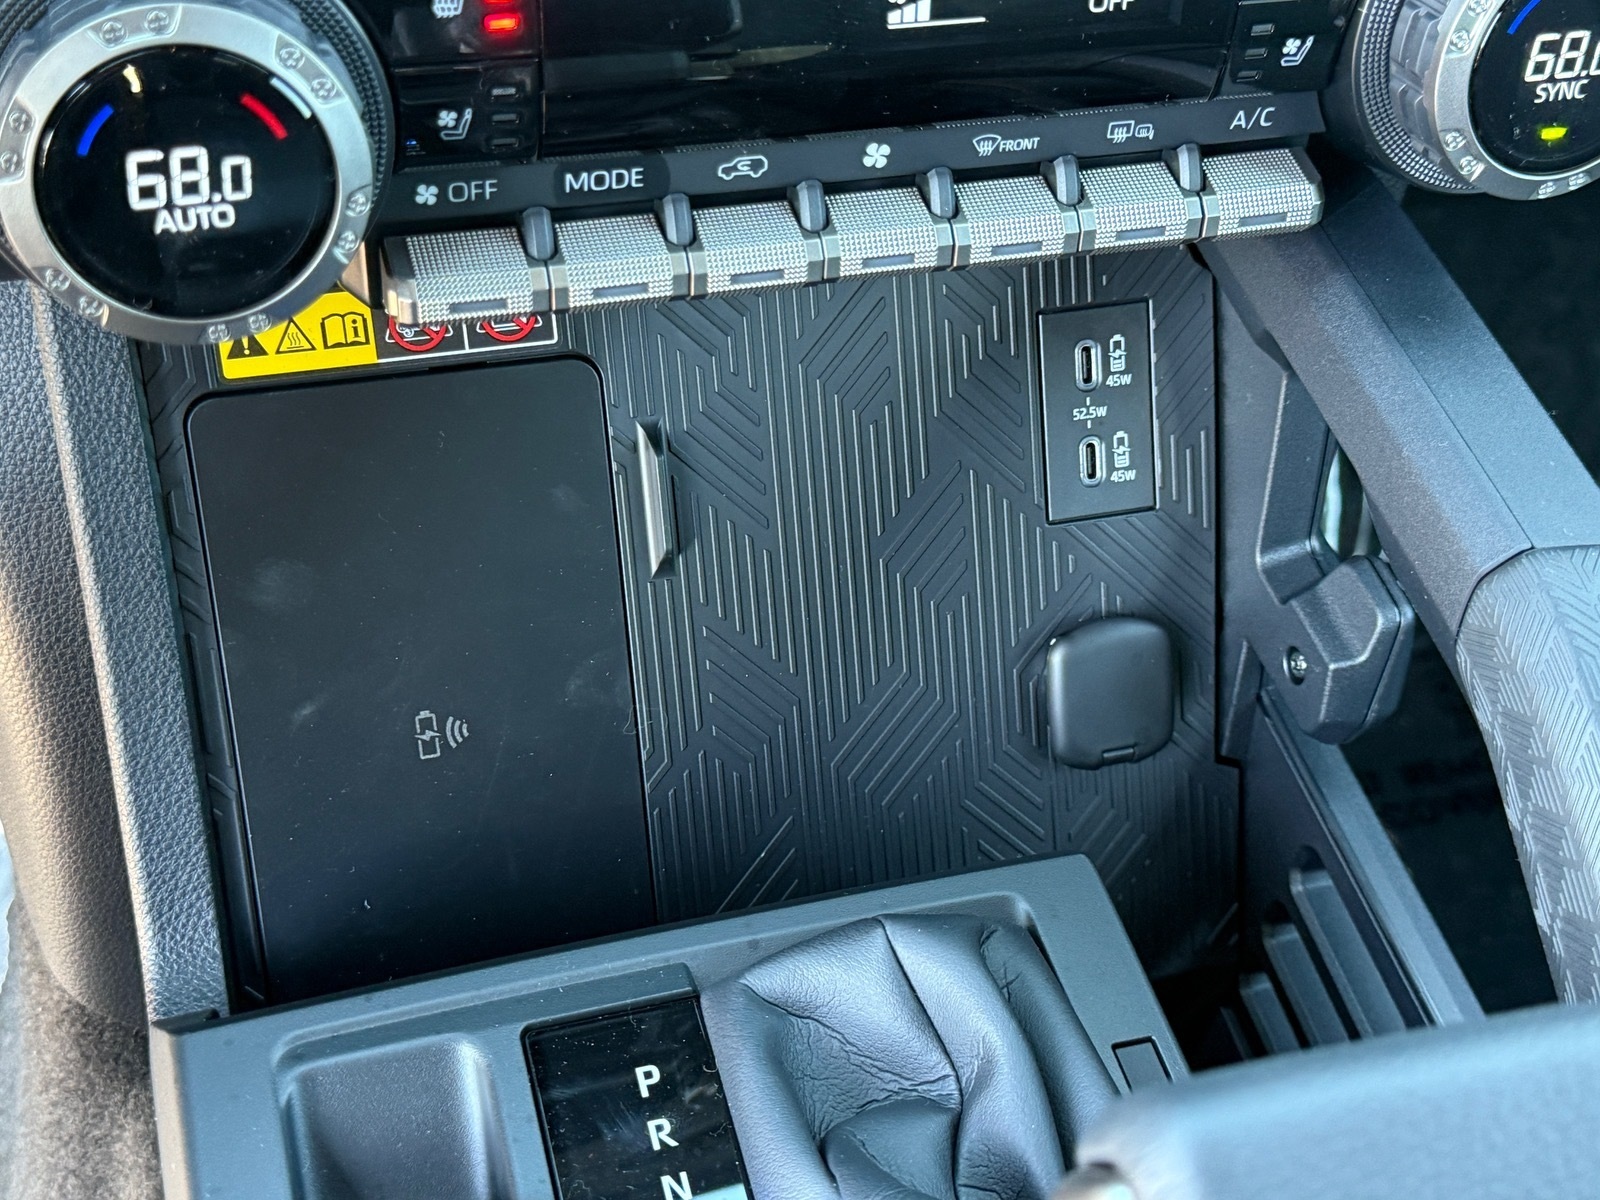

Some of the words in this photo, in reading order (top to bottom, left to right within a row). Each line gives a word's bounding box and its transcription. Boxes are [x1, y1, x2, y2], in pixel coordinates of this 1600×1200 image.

[1534, 78, 1590, 103] SYNC
[1229, 106, 1275, 130] A/C
[999, 137, 1040, 152] FRONT
[125, 144, 253, 212] 68.0
[564, 167, 644, 193] MODE
[448, 179, 498, 203] OFF
[154, 202, 236, 236] AUTO
[1106, 373, 1132, 387] 45W
[1073, 405, 1108, 421] 52.5W
[1110, 469, 1136, 483] 45W
[635, 1064, 661, 1098] P
[647, 1117, 679, 1151] R
[660, 1171, 693, 1200] N
